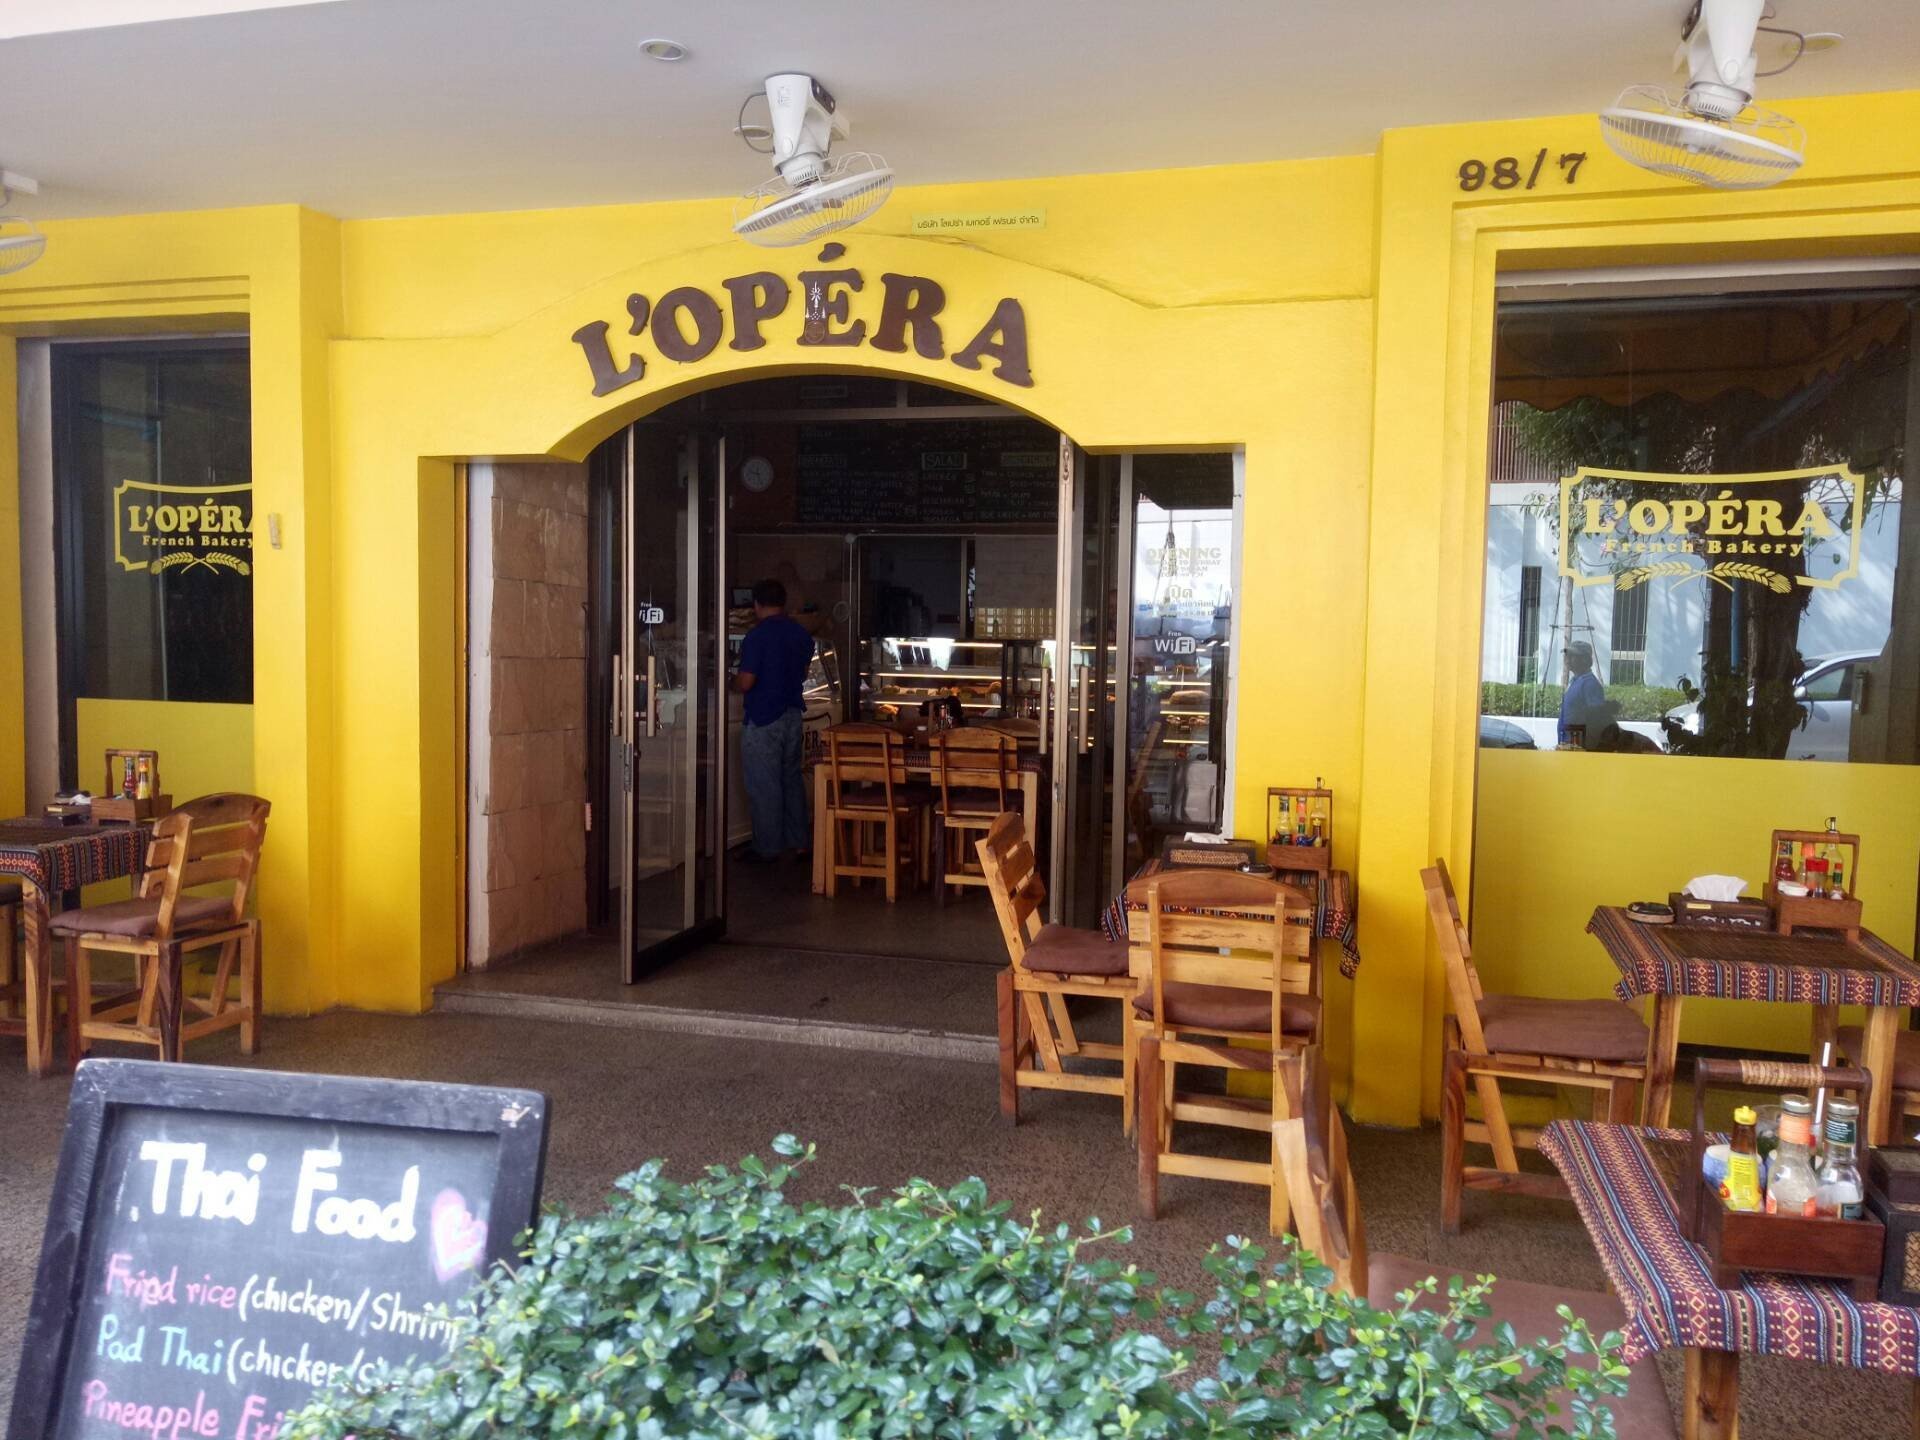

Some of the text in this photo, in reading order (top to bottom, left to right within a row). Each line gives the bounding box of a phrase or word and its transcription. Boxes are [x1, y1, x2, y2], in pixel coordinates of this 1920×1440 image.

[1458, 148, 1587, 191] 98/7
[571, 242, 1034, 397] L'OPÉRA
[1582, 490, 1834, 536] L'OPÉRA
[142, 535, 253, 548] French Bakery
[1604, 540, 1803, 557] French Bakery
[639, 607, 664, 624] iFi
[1155, 636, 1196, 655] WiFi
[138, 1141, 420, 1243] Thai Food
[97, 1314, 144, 1362] Pad
[82, 1380, 219, 1440] Pineapple
